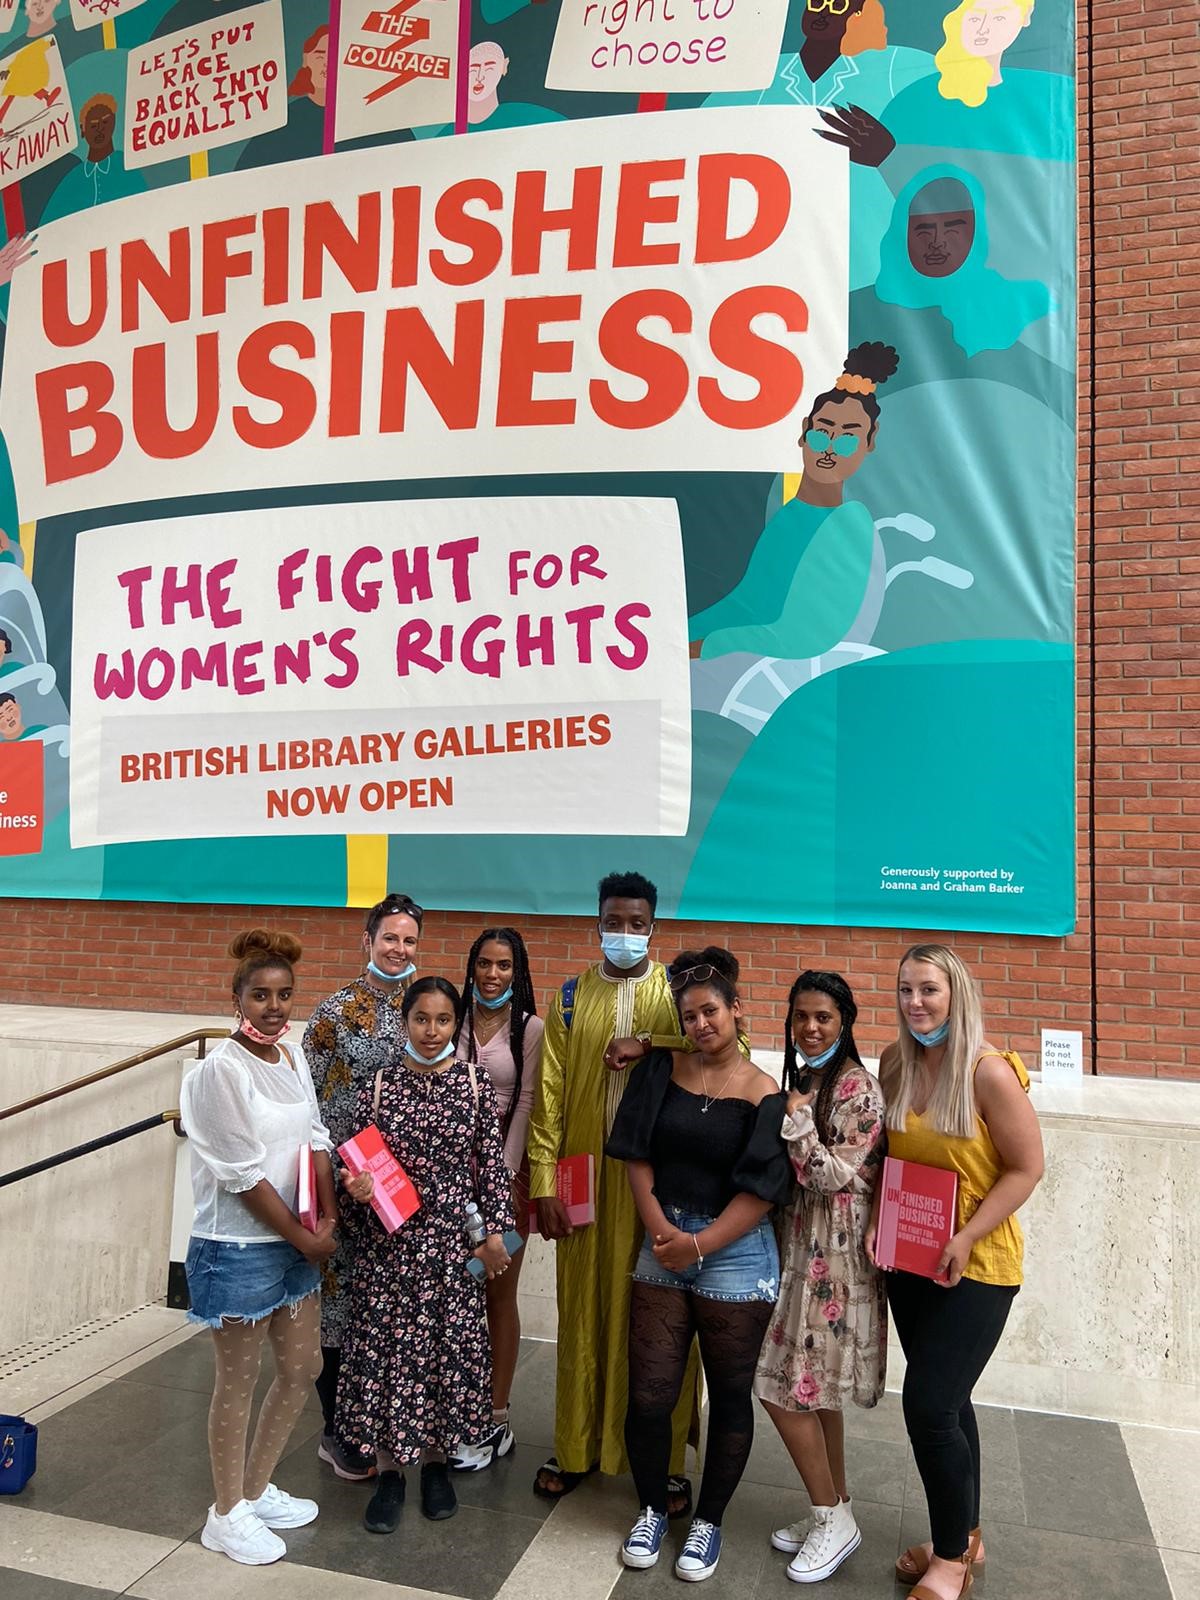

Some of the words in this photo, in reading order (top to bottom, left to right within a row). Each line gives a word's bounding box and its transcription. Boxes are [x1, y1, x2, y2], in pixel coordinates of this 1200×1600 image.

[378, 13, 418, 36] THE
[139, 38, 200, 76] LET'S
[211, 22, 255, 51] PUT
[347, 45, 449, 77] COURAGE
[591, 36, 727, 69] choose
[162, 52, 232, 90] RACE
[135, 83, 201, 123] BACK
[213, 59, 279, 101] INTO
[132, 86, 270, 152] EQUALITY
[41, 152, 793, 348] UNFINISHED
[34, 284, 810, 487] BUSINESS
[117, 558, 242, 630] THE
[276, 536, 480, 613] FIGHT
[508, 544, 608, 595] FOR
[92, 627, 360, 701] WOMEN'S
[395, 602, 652, 679] RIGHTS
[119, 740, 249, 784] BRITISH
[258, 730, 406, 773] LIBRARY
[413, 713, 612, 761] GALLERIES
[266, 783, 351, 819] NOW
[359, 776, 454, 811] OPEN
[880, 865, 941, 880] Generously
[942, 869, 998, 881] supported
[1000, 868, 1015, 882] by
[880, 879, 918, 890] Joanna
[920, 880, 940, 891] and
[943, 881, 986, 892] Graham
[989, 882, 1025, 894] Barker
[1045, 1040, 1071, 1049] Please
[1045, 1050, 1056, 1058] do
[1057, 1051, 1072, 1059] not
[1057, 1060, 1075, 1069] here
[887, 1187, 944, 1215] UNFINISHED
[899, 1205, 946, 1231] BUSINESS
